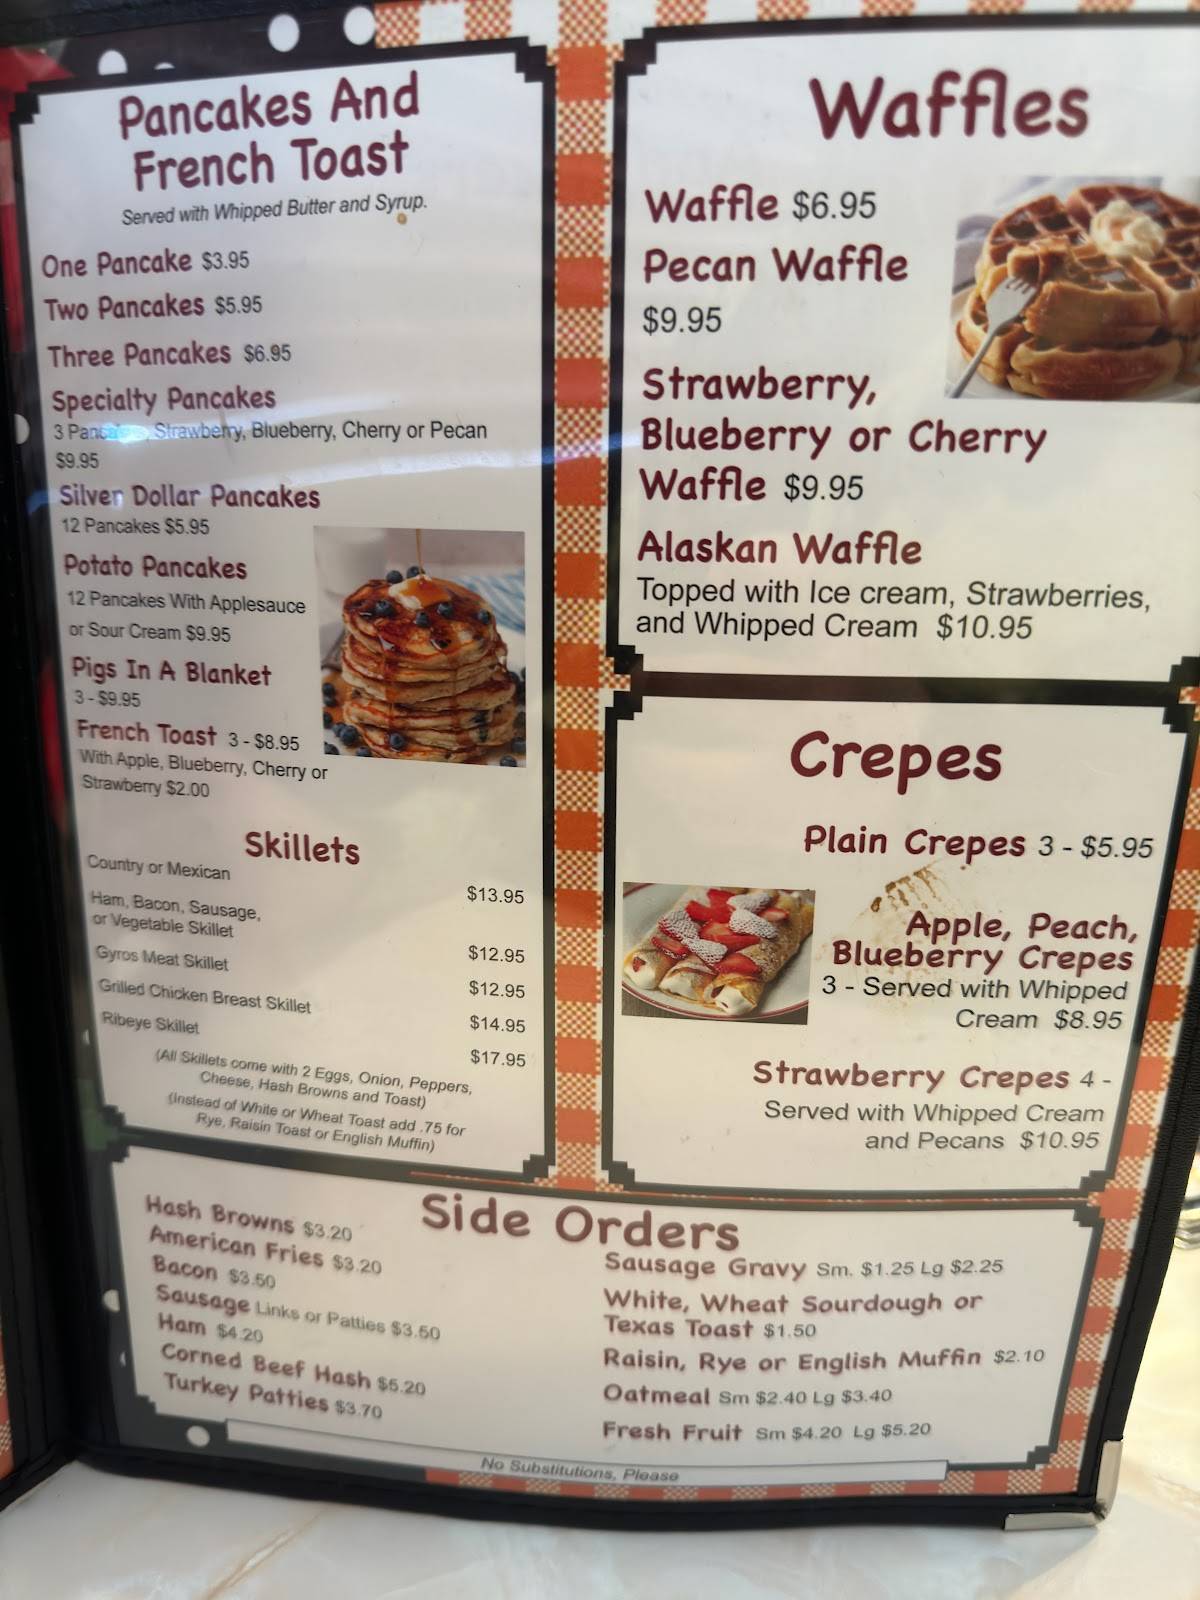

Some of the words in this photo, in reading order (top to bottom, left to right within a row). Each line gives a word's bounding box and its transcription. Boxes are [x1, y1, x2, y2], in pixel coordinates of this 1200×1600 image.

[119, 85, 312, 140] Pancakes
[330, 70, 419, 122] And
[809, 68, 1089, 140] Waffles
[134, 140, 274, 192] French
[290, 129, 409, 181] Toast
[122, 207, 175, 226] Served
[179, 205, 209, 222] with
[214, 200, 283, 222] Whipped
[287, 199, 336, 216] Butter
[339, 195, 371, 213] and
[375, 193, 427, 214] Syrup.
[644, 183, 779, 223] Waffle
[792, 190, 876, 222] $6.95
[42, 254, 88, 278] One
[97, 248, 192, 276] Pancake
[202, 250, 249, 271] $3.95
[644, 248, 756, 283] Pecan
[772, 244, 908, 282] Waffle
[44, 298, 89, 321] Two
[98, 293, 205, 320] Pancakes
[215, 295, 262, 315] $5.95
[643, 305, 722, 336] $9.95
[47, 345, 115, 368] Three
[124, 340, 232, 366] Pancakes
[244, 344, 291, 364] $6.95
[52, 387, 157, 419] Specialty
[168, 385, 276, 410] Pancakes
[643, 365, 876, 410] Strawberry,
[641, 417, 831, 460] Blueberry
[849, 426, 892, 452] or
[909, 419, 1047, 463] Cherry
[56, 452, 99, 469] $9.95
[60, 484, 123, 506] Silver
[131, 484, 200, 507] Dollar
[211, 484, 320, 509] Pancakes
[639, 465, 766, 501] Waffle
[784, 473, 863, 503] $9.95
[62, 517, 80, 533] 12
[84, 517, 161, 534] Pancakes
[164, 517, 210, 535] $5.95
[637, 530, 777, 563] Alaskan
[793, 530, 922, 565] Waffle
[64, 553, 133, 577] Potato
[142, 555, 248, 580] Pancakes
[637, 577, 735, 607] Topped
[745, 579, 798, 603] with
[810, 580, 850, 604] Ice
[860, 586, 954, 608] cream,
[967, 581, 1150, 612] Strawberries,
[70, 625, 85, 636] or
[88, 621, 125, 638] Sour
[129, 623, 181, 640] Cream
[186, 625, 231, 643] $9.95
[636, 611, 684, 634] and
[694, 611, 814, 642] Whipped
[825, 613, 917, 638] Cream
[937, 613, 1032, 641] $10.95
[72, 656, 117, 685] Pigs
[126, 659, 150, 680] In
[160, 660, 176, 681] A
[185, 661, 272, 686] Blanket
[77, 719, 149, 742] French
[156, 723, 217, 746] Toast
[229, 732, 238, 747] 3
[255, 733, 299, 751] $8.95
[790, 730, 1002, 795] Crepes
[245, 831, 360, 865] Skillets
[804, 825, 887, 854] Plain
[905, 829, 1026, 865] Crepes
[1038, 835, 1053, 856] 3
[1081, 835, 1154, 859] $5.95
[88, 854, 144, 876] Country
[148, 863, 164, 874] or
[167, 861, 230, 880] Mexican
[92, 891, 129, 909] Ham,
[133, 894, 184, 914] Bacon,
[189, 900, 261, 922] Sausage,
[467, 885, 524, 904] $13.95
[906, 910, 1011, 945] Apple,
[1028, 912, 1137, 944] Peach,
[96, 945, 139, 963] Gyros
[142, 950, 180, 967] Meat
[183, 954, 229, 972] Skillet
[469, 945, 525, 963] $12.95
[832, 940, 1003, 975] Blueberry
[1019, 945, 1133, 978] Crepes
[469, 980, 525, 998] $12.95
[822, 975, 836, 994] 3
[863, 976, 952, 998] Served
[960, 979, 1009, 998] with
[1019, 979, 1128, 1004] Whipped
[470, 1015, 525, 1033] $14.95
[956, 1009, 1038, 1028] Cream
[1054, 1009, 1123, 1030] $8.95
[471, 1049, 526, 1067] $17.95
[753, 1060, 945, 1094] Strawberry
[960, 1065, 1070, 1096] Crepes
[1080, 1070, 1094, 1088] 4
[865, 1132, 909, 1149] and
[918, 1132, 1004, 1149] Pecans
[1020, 1131, 1100, 1151] $10.95
[146, 1194, 202, 1220] Hash
[211, 1204, 295, 1235] Browns
[303, 1221, 352, 1242] $3.20
[422, 1193, 530, 1237] Side
[555, 1205, 739, 1252] Orders
[149, 1224, 256, 1257] American
[266, 1242, 324, 1268] Fries
[332, 1254, 382, 1275] $3.20
[152, 1254, 218, 1281] Bacon
[228, 1268, 276, 1290] $3.50
[605, 1252, 715, 1281] Sausage
[728, 1257, 807, 1282] Gravy
[817, 1262, 853, 1277] Sm.
[861, 1261, 914, 1278] $1.25
[921, 1261, 944, 1278] Lg
[950, 1259, 1003, 1275] $2.25
[604, 1288, 689, 1314] White,
[701, 1294, 789, 1313] Wheat
[802, 1292, 942, 1317] Sourdough
[954, 1295, 983, 1310] or
[158, 1312, 206, 1336] Ham
[216, 1323, 263, 1344] $4.20
[604, 1314, 675, 1336] Texas
[685, 1319, 754, 1338] Toast
[764, 1323, 816, 1339] $1.50
[604, 1348, 685, 1372] Raisin,
[699, 1352, 746, 1375] Rye
[758, 1358, 786, 1372] or
[798, 1352, 887, 1376] English
[898, 1348, 981, 1368] Muffin
[993, 1349, 1045, 1364] $2.10
[164, 1372, 239, 1402] Turkey
[249, 1384, 329, 1413] Patties
[335, 1400, 383, 1420] $3.70
[603, 1384, 710, 1405] Oatmeal
[719, 1391, 749, 1405] Sm
[756, 1391, 807, 1406] $2.40
[813, 1391, 835, 1407] Lg
[841, 1389, 892, 1404] $3.40
[603, 1421, 671, 1440] Fresh
[683, 1424, 742, 1441] Fruit
[756, 1427, 786, 1441] Sm
[792, 1426, 842, 1441] $4.20
[854, 1426, 875, 1441] Lg
[881, 1423, 931, 1438] $5.20
[481, 1456, 504, 1471] No
[510, 1459, 616, 1480] Substitutions,
[623, 1468, 679, 1481] Please
